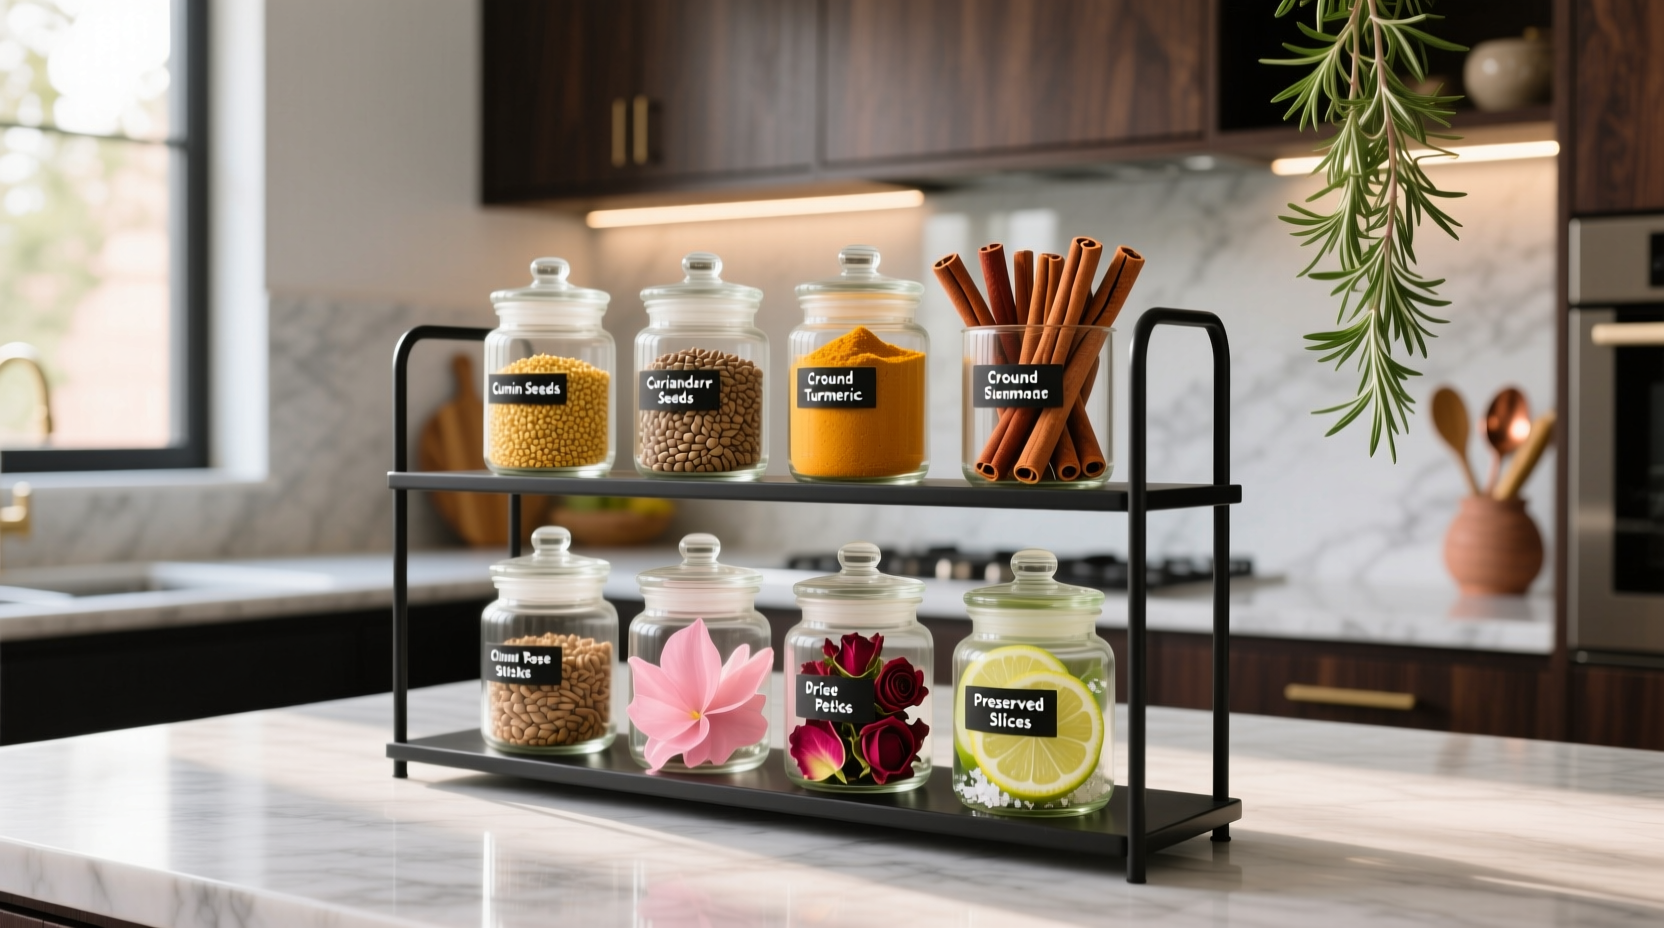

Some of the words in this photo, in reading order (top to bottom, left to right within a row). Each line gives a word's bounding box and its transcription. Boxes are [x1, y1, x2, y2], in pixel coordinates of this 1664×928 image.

[525, 381, 561, 396] Seeds
[803, 387, 863, 402] Turmeric
[657, 390, 694, 405] Seeds
[973, 692, 1045, 712] Preserved
[989, 711, 1032, 729] Slices
